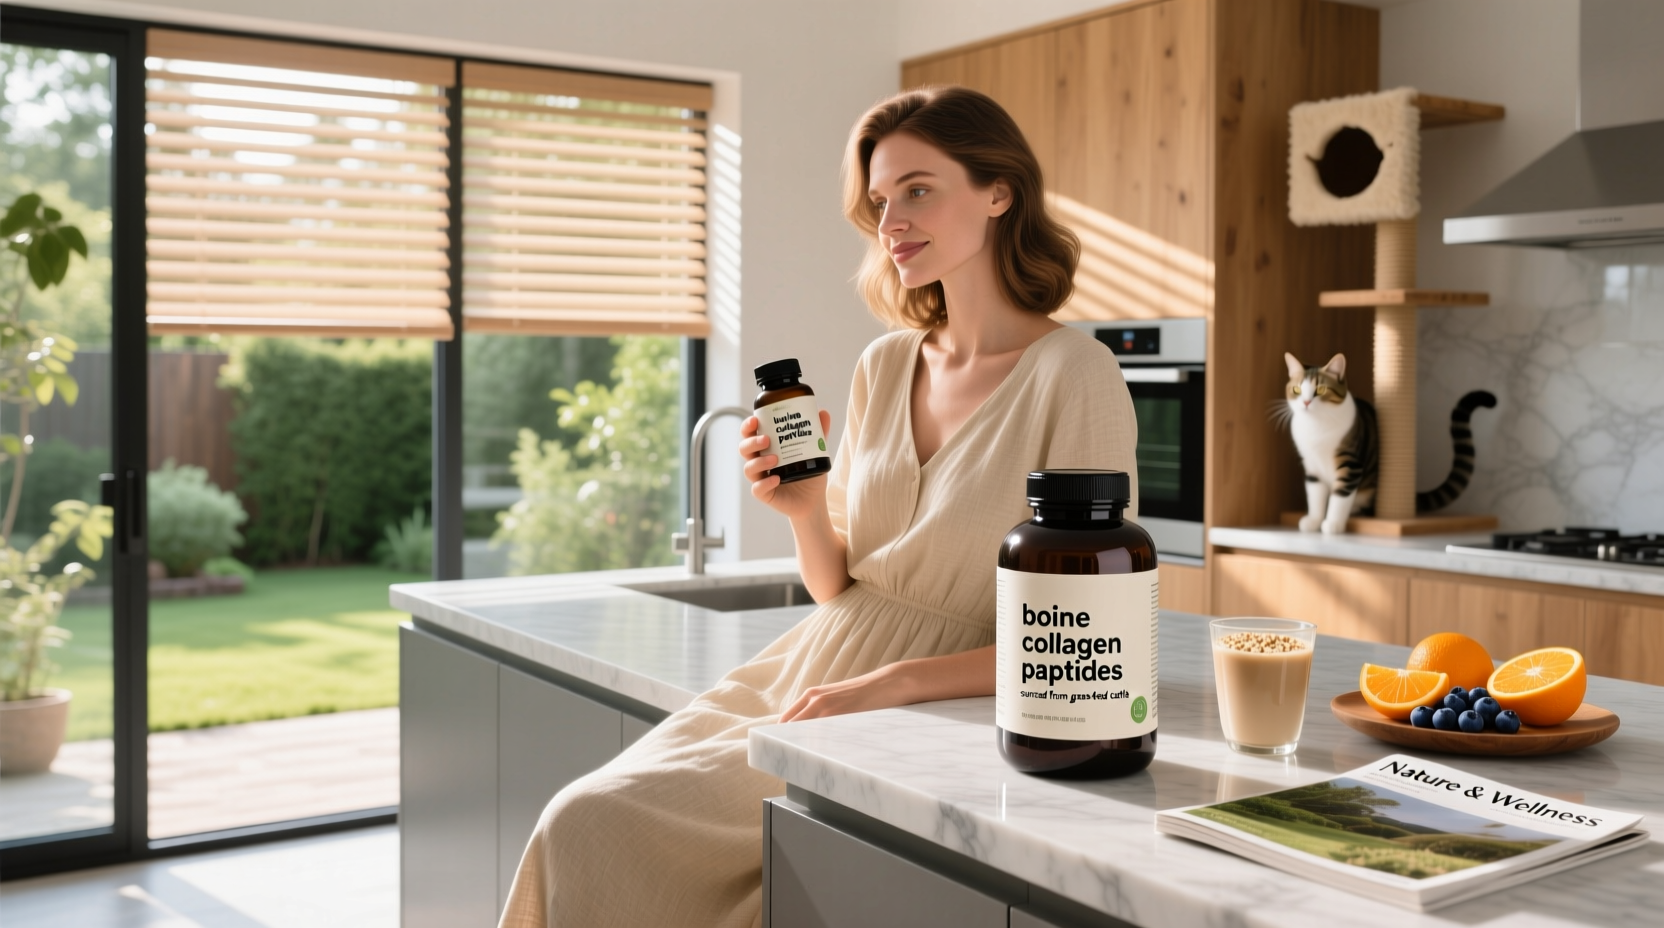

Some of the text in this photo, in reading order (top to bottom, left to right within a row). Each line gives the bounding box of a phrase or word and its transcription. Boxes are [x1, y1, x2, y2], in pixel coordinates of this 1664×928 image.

[1022, 602, 1091, 628] boine
[1021, 632, 1122, 660] collagen
[1021, 659, 1123, 686] paptides
[1379, 761, 1461, 791] Nature
[1463, 786, 1485, 800] &
[1491, 791, 1603, 827] Wellness
